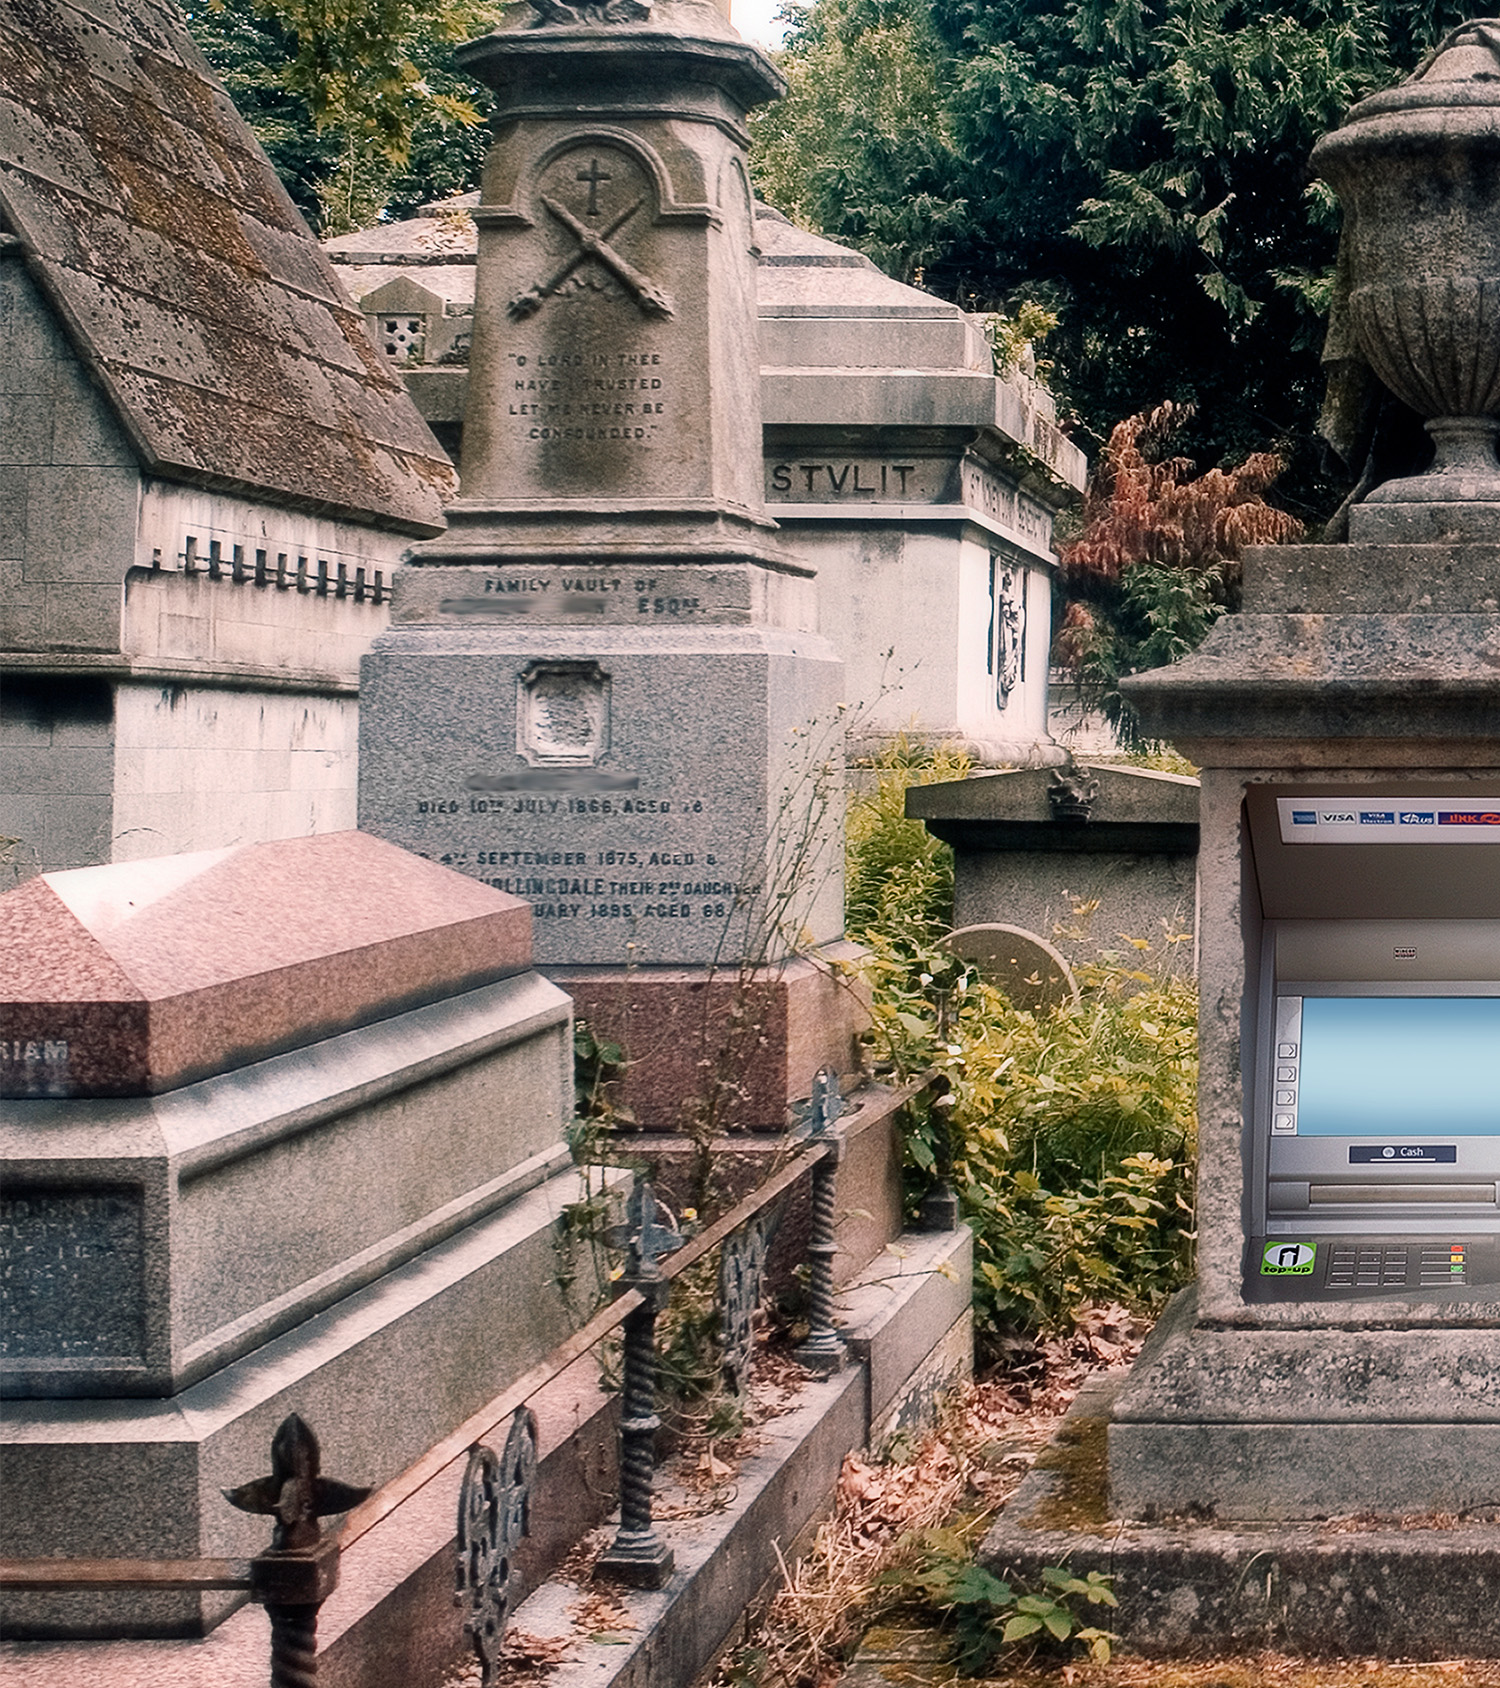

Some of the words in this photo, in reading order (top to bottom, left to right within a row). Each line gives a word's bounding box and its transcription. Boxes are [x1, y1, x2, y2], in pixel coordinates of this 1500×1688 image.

[537, 354, 582, 367] LORD
[593, 354, 608, 367] IN
[617, 353, 661, 366] THEE
[515, 379, 561, 391] HAVE
[582, 378, 662, 391] TRUSTED
[508, 403, 538, 416] LET
[548, 404, 571, 416] ME
[580, 403, 635, 416] NEVER
[642, 402, 665, 414] BE
[771, 464, 915, 493] STVLIT
[484, 579, 551, 593] FAMILY
[562, 578, 622, 592] VAULT
[634, 579, 657, 592] OF
[418, 800, 460, 814] DIED
[513, 799, 558, 813] JULY
[623, 799, 671, 814] AGED
[1323, 813, 1355, 822] VISA
[476, 851, 587, 866] SEPTEMBER
[649, 852, 695, 866] AGED
[608, 881, 654, 895] THEIR
[644, 903, 691, 917] AGED
[1400, 1146, 1424, 1157] Cash
[1263, 1265, 1311, 1275] top-up
